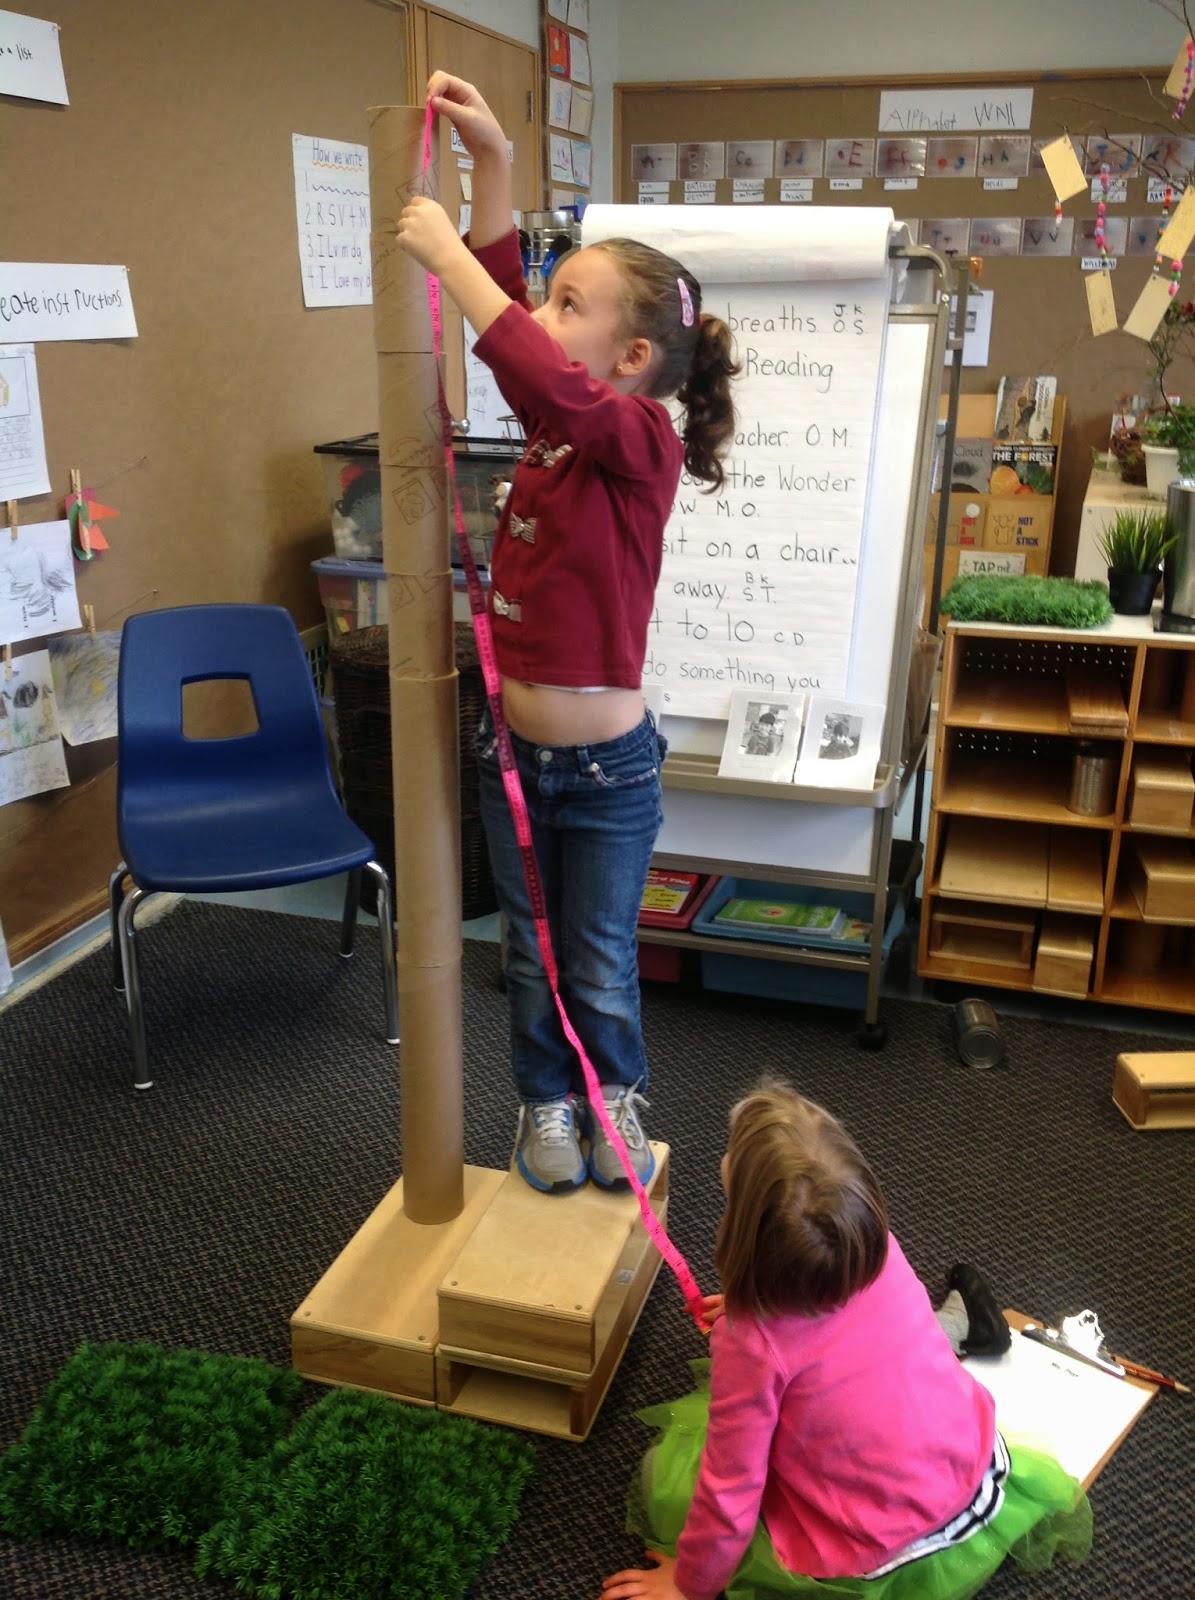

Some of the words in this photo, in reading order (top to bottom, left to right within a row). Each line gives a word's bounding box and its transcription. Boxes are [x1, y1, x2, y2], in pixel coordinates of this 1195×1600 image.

[312, 138, 331, 163] How
[745, 347, 834, 394] Reading
[992, 452, 1012, 461] THE
[728, 460, 766, 490] the
[778, 463, 856, 492] Wonder
[1017, 527, 1022, 535] A
[1018, 517, 1034, 526] NOT
[705, 541, 732, 558] on
[745, 543, 760, 560] a
[973, 561, 996, 572] TAP
[677, 608, 709, 641] to
[679, 657, 776, 691] something
[787, 675, 821, 694] you
